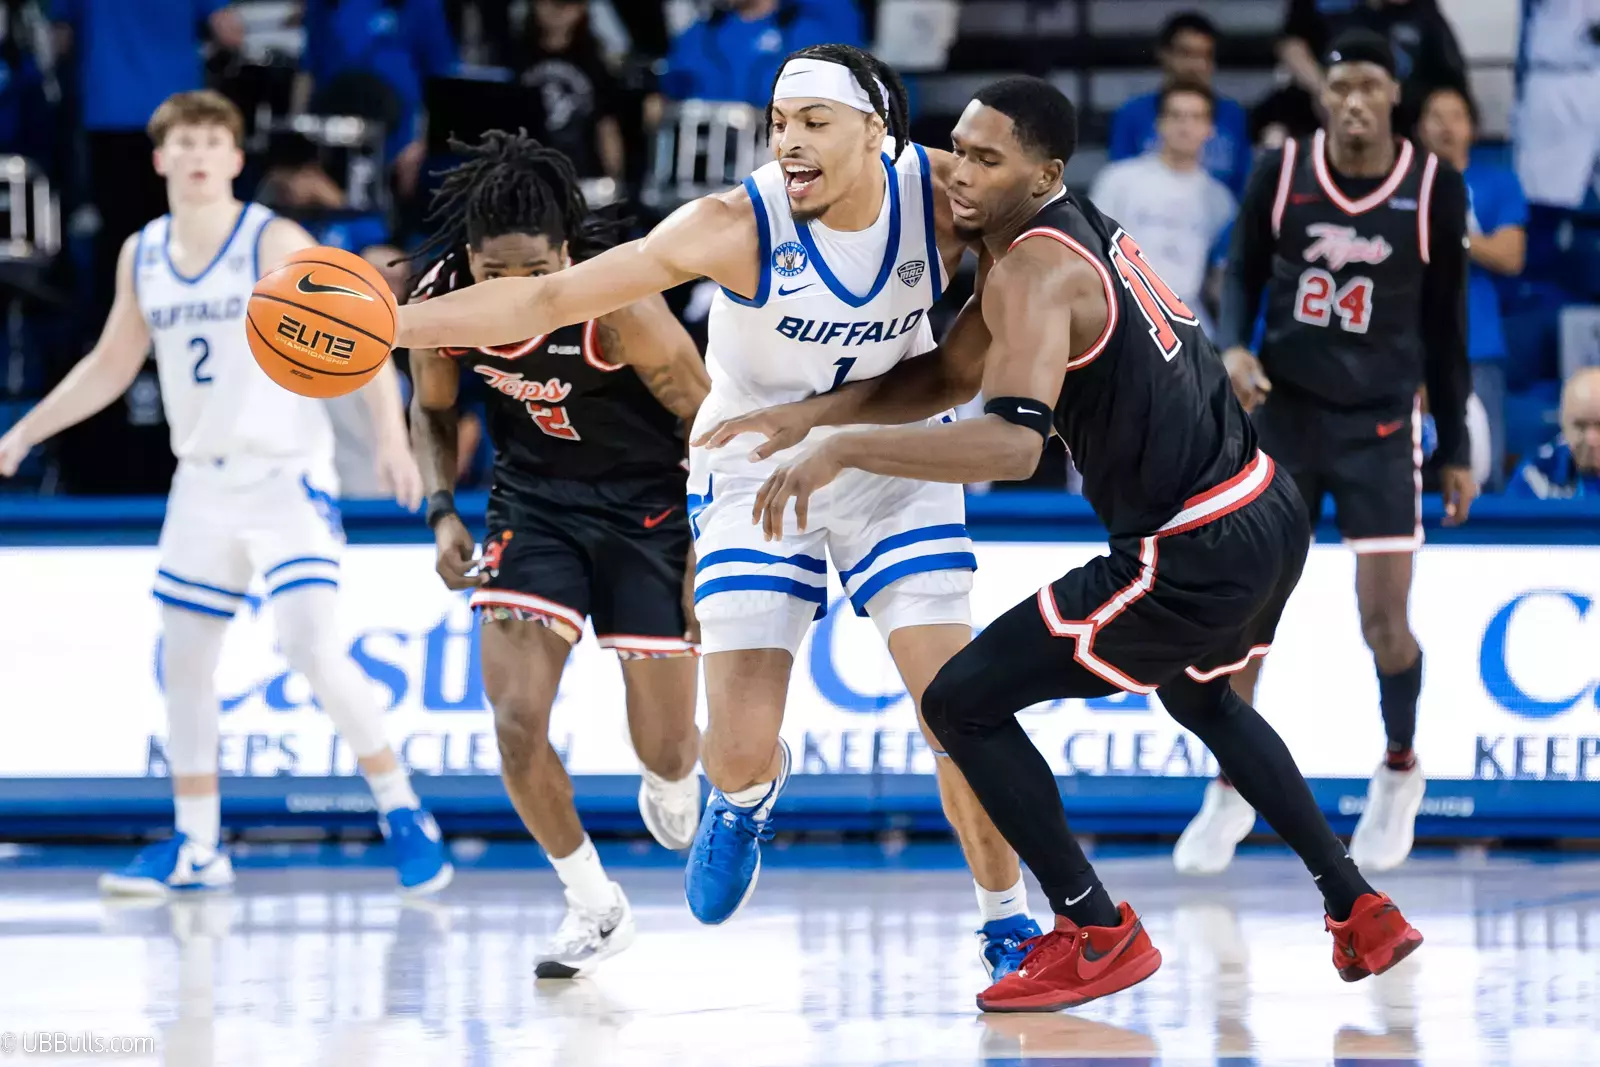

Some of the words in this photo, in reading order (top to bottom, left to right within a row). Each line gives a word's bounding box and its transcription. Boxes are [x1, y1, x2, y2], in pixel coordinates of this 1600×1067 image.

[1293, 267, 1374, 334] 24
[277, 313, 356, 360] ELITE
[775, 308, 924, 346] BUFFALO
[188, 336, 213, 383] 2
[832, 356, 858, 392] 1
[473, 364, 572, 403] Tops
[525, 401, 581, 441] 2
[802, 731, 938, 774] KEEP
